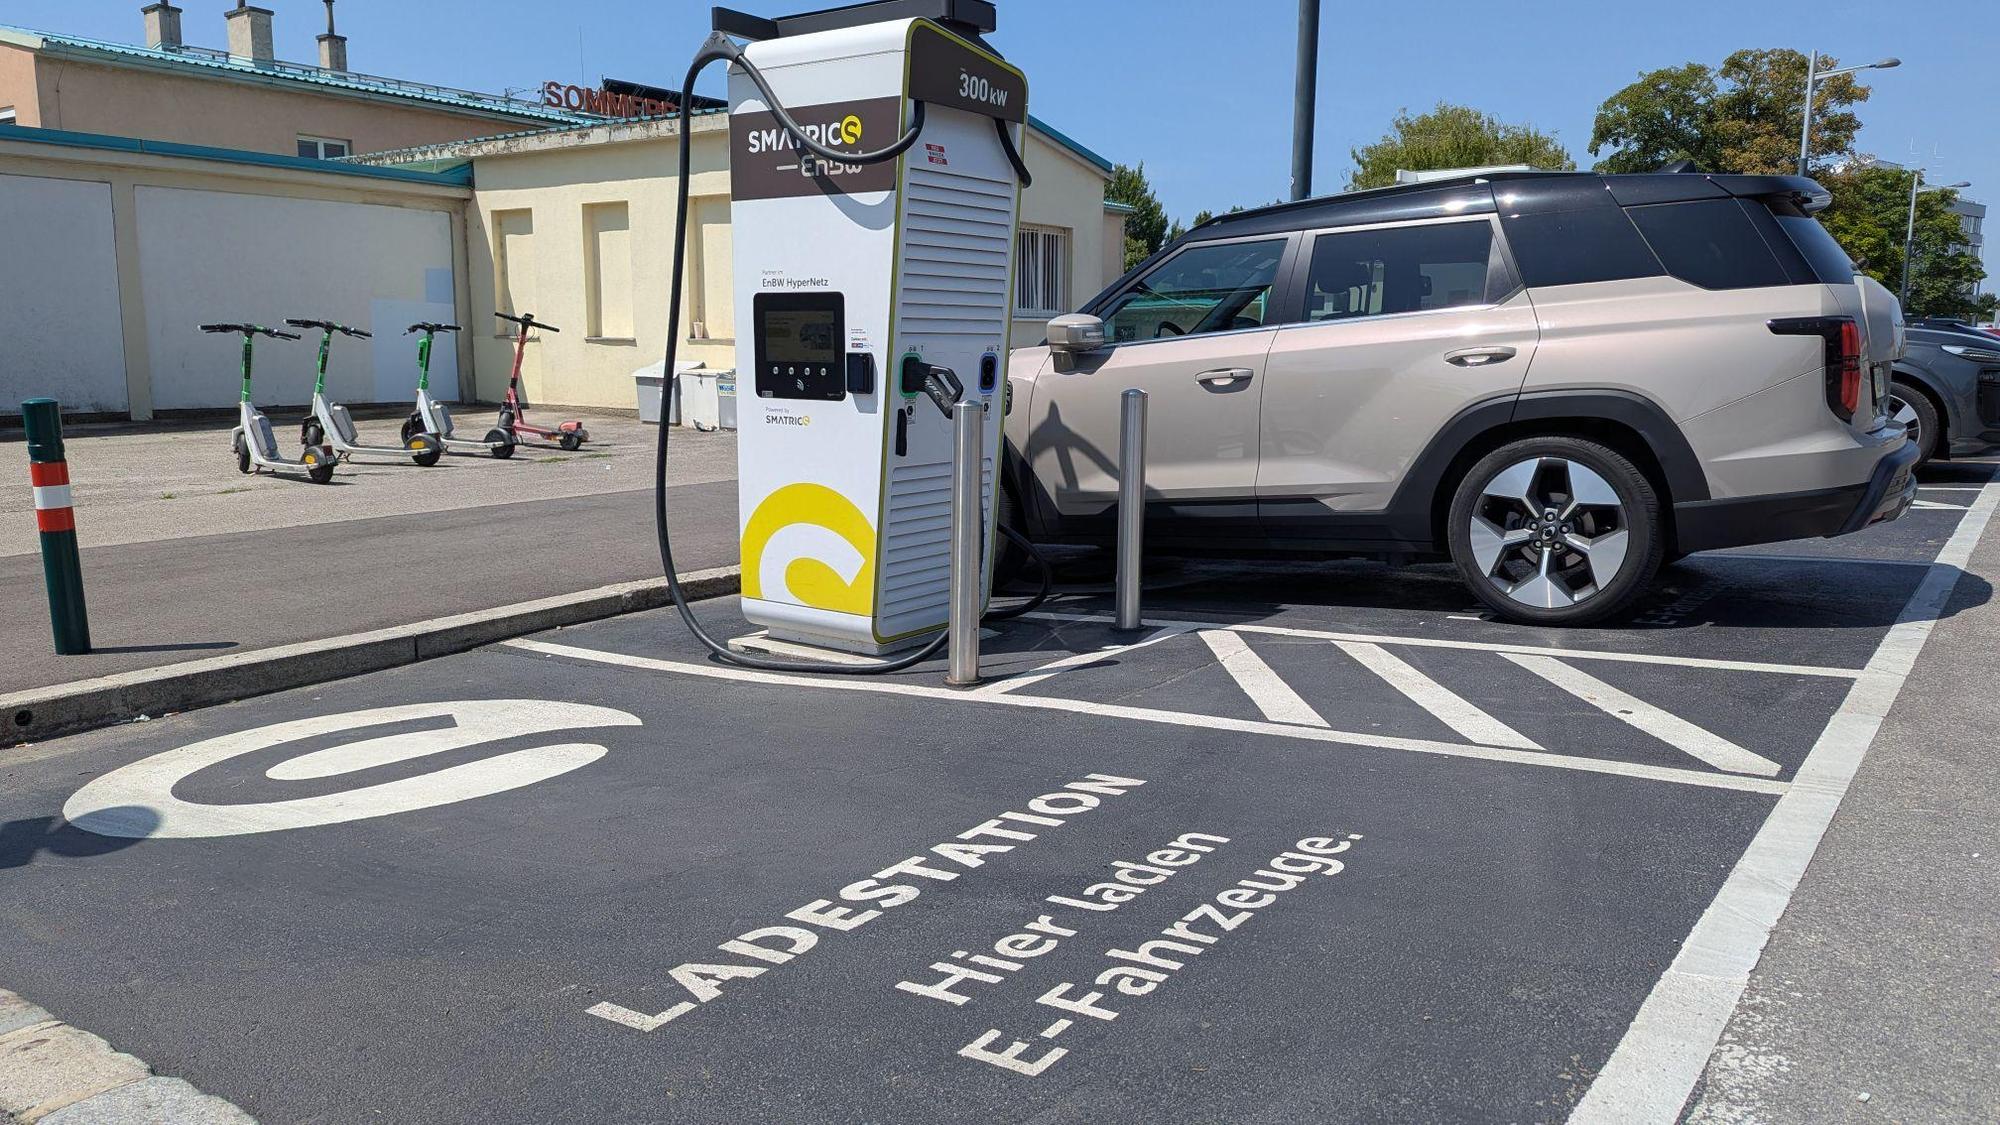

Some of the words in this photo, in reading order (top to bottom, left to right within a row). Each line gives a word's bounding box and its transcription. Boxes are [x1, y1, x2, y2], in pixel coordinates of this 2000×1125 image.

[959, 73, 988, 102] 300
[989, 86, 1009, 108] kW
[762, 278, 785, 287] EnBW
[786, 277, 829, 289] HyperNetz
[584, 773, 1147, 1032] LADESTATION
[895, 914, 1077, 1006] Hier
[1045, 832, 1231, 912] laden
[957, 833, 1364, 1077] E-Fahrzeuge.
